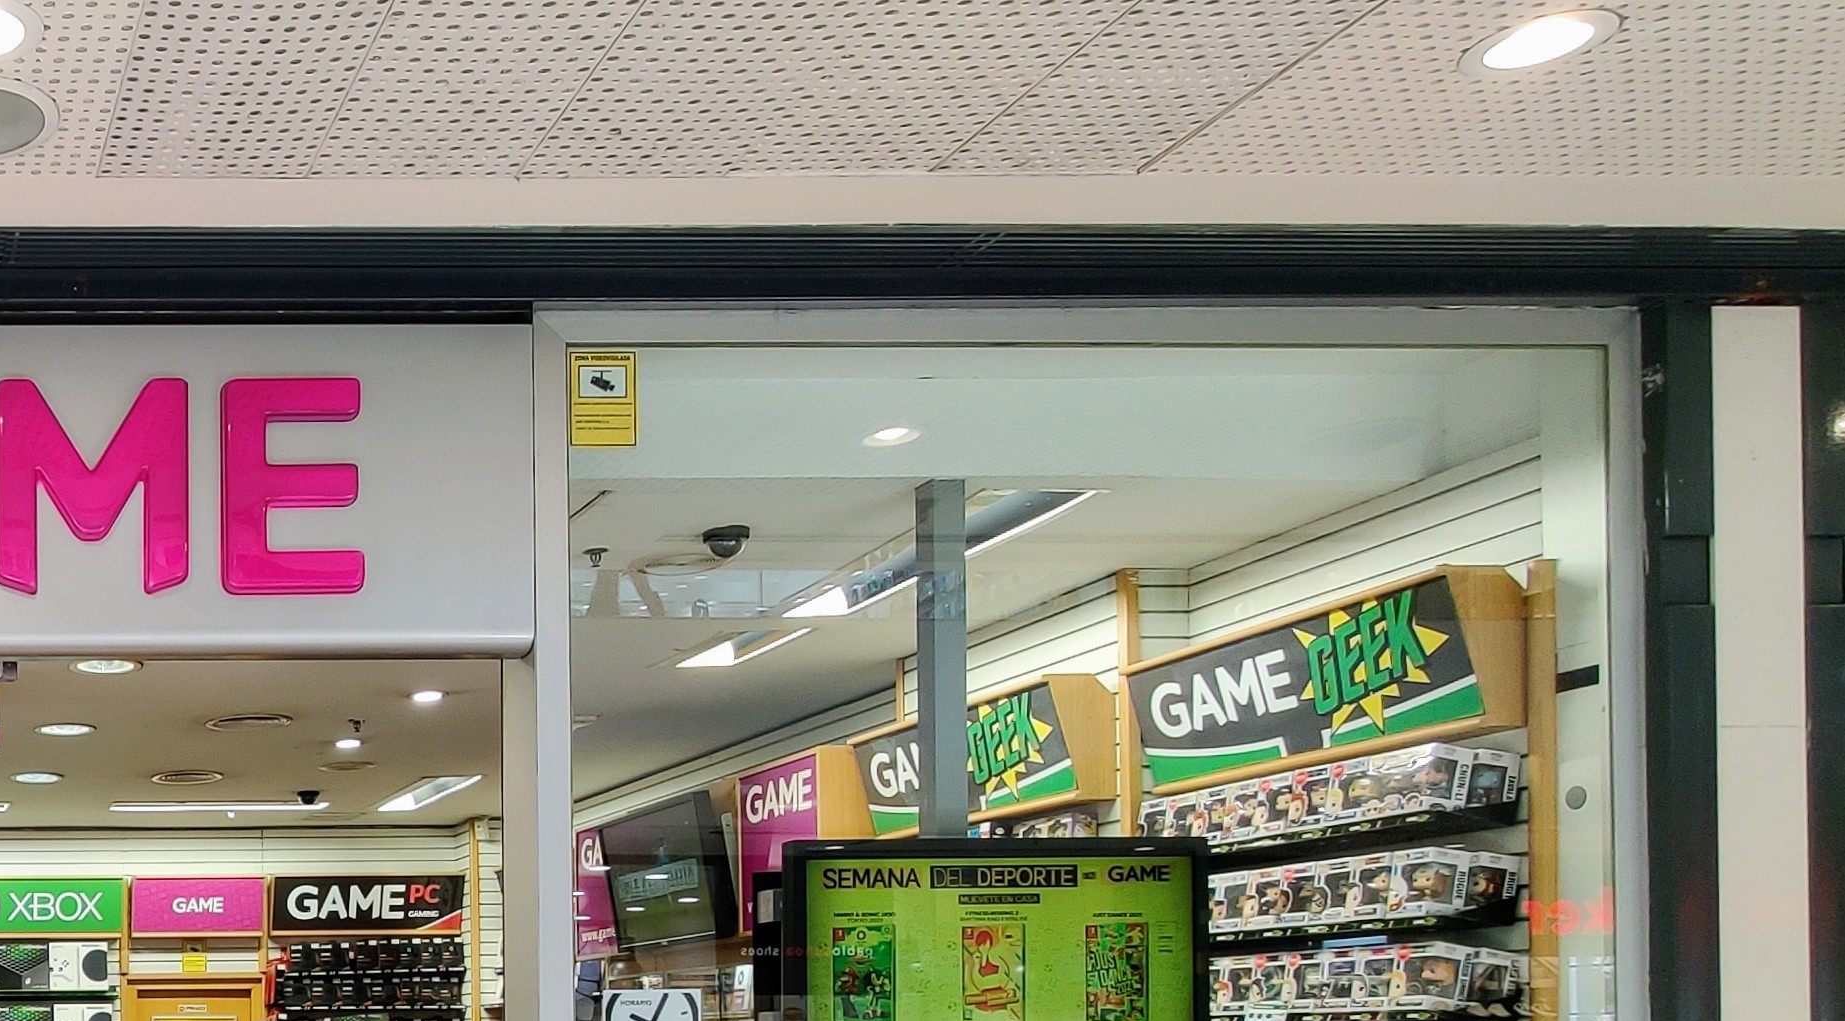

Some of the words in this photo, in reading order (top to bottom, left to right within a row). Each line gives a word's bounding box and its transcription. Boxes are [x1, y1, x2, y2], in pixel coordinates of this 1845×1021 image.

[1150, 649, 1300, 739] GAME
[1308, 590, 1426, 715] GEEK
[870, 740, 919, 798] GA
[745, 768, 812, 824] GAME
[823, 868, 921, 889] SEMANA
[934, 867, 971, 888] DEL
[977, 867, 1075, 887] DEPORTE
[1107, 865, 1170, 883] GAME
[7, 891, 103, 922] XBOX
[172, 896, 225, 914] GAME
[287, 884, 406, 920] GAME
[409, 884, 441, 904] PC
